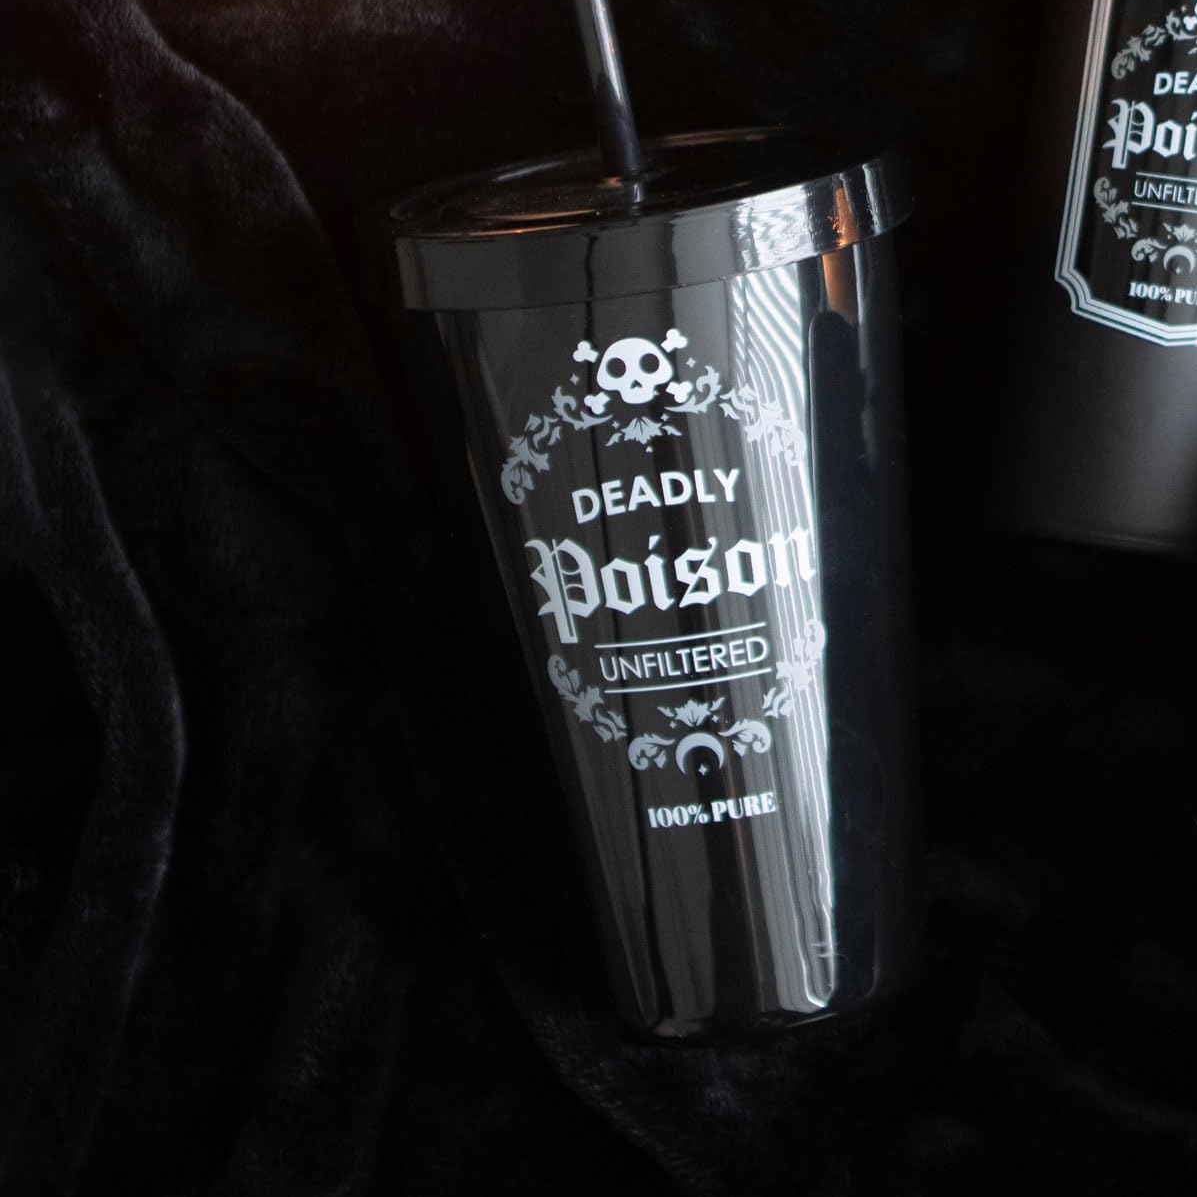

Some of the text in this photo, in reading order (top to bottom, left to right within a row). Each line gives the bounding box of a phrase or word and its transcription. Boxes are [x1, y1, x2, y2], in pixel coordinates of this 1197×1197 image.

[1128, 281, 1172, 303] 100%
[572, 468, 740, 524] DEADLY
[524, 525, 816, 643] Poison
[600, 636, 769, 682] UNFILTERED
[648, 791, 777, 828] 100% PURE
